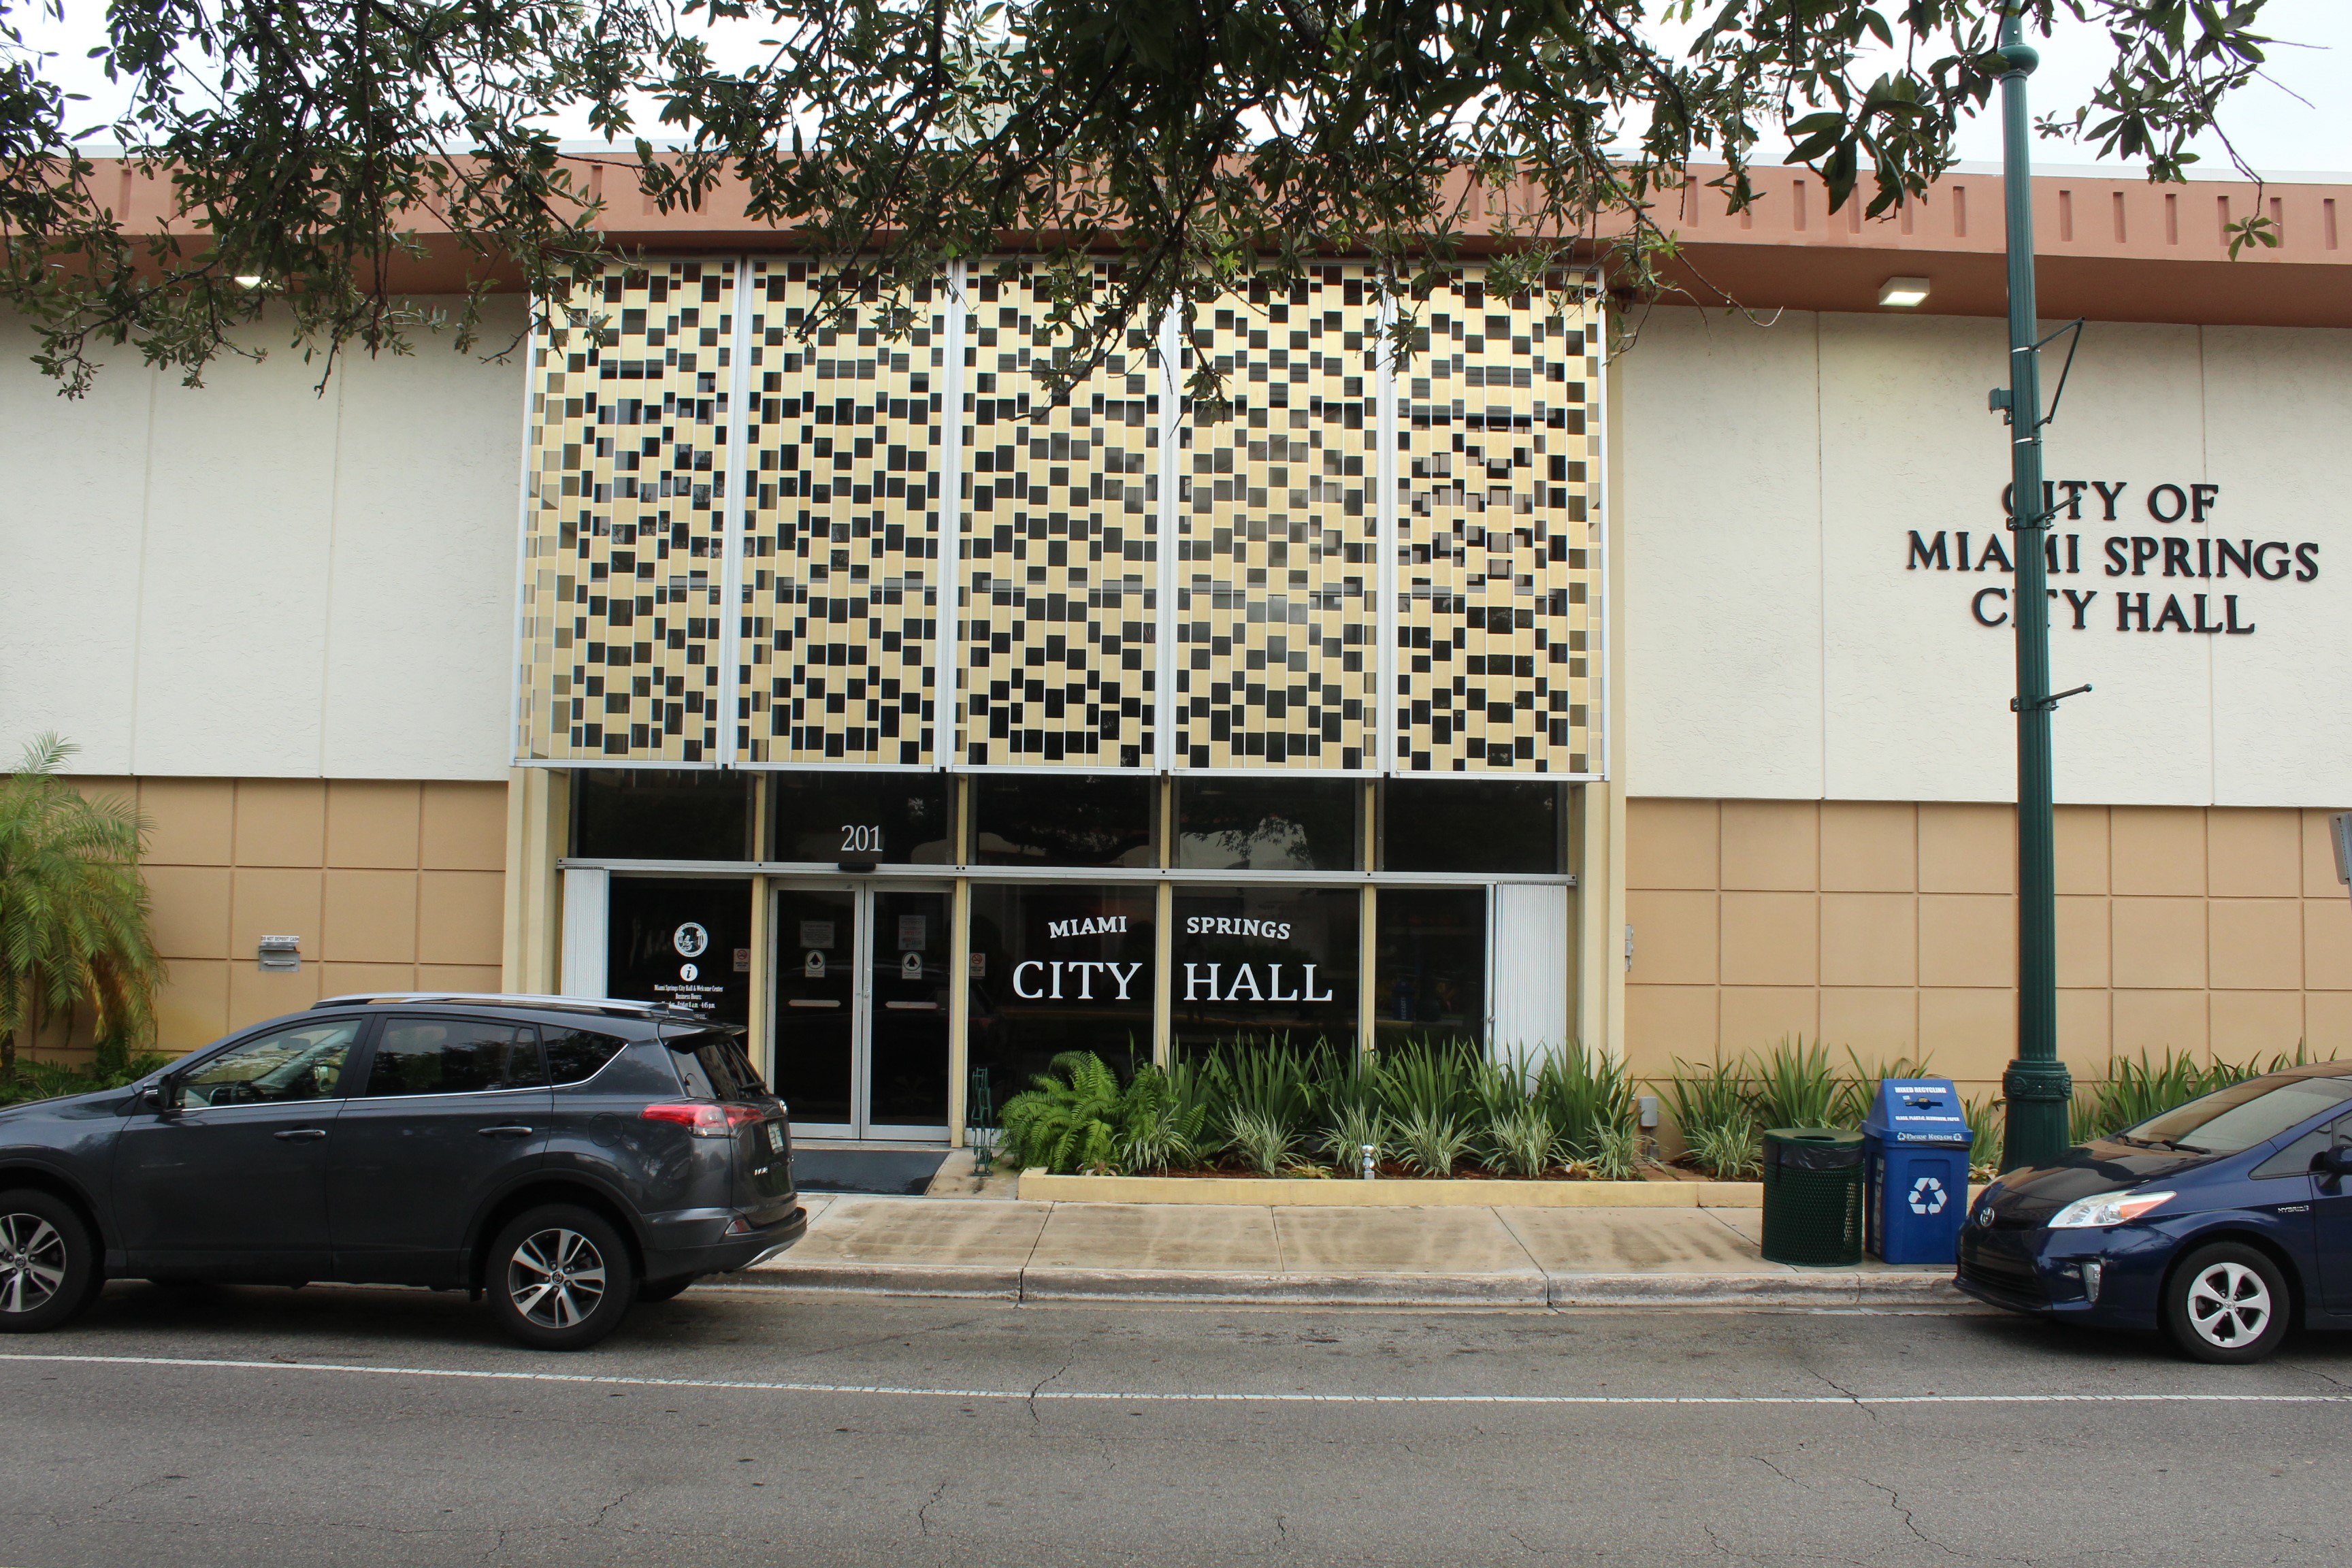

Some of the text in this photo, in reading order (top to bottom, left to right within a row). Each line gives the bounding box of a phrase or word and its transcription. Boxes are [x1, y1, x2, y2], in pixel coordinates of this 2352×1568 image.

[2147, 483, 2219, 524] OF
[2104, 536, 2319, 583] SPRINGS
[1972, 587, 2255, 634] CY HALL
[840, 825, 883, 851] 201
[1048, 915, 1291, 940] MIAMI SPRINGS
[666, 984, 679, 992] Springs
[1013, 960, 1333, 1002] CITY HALL
